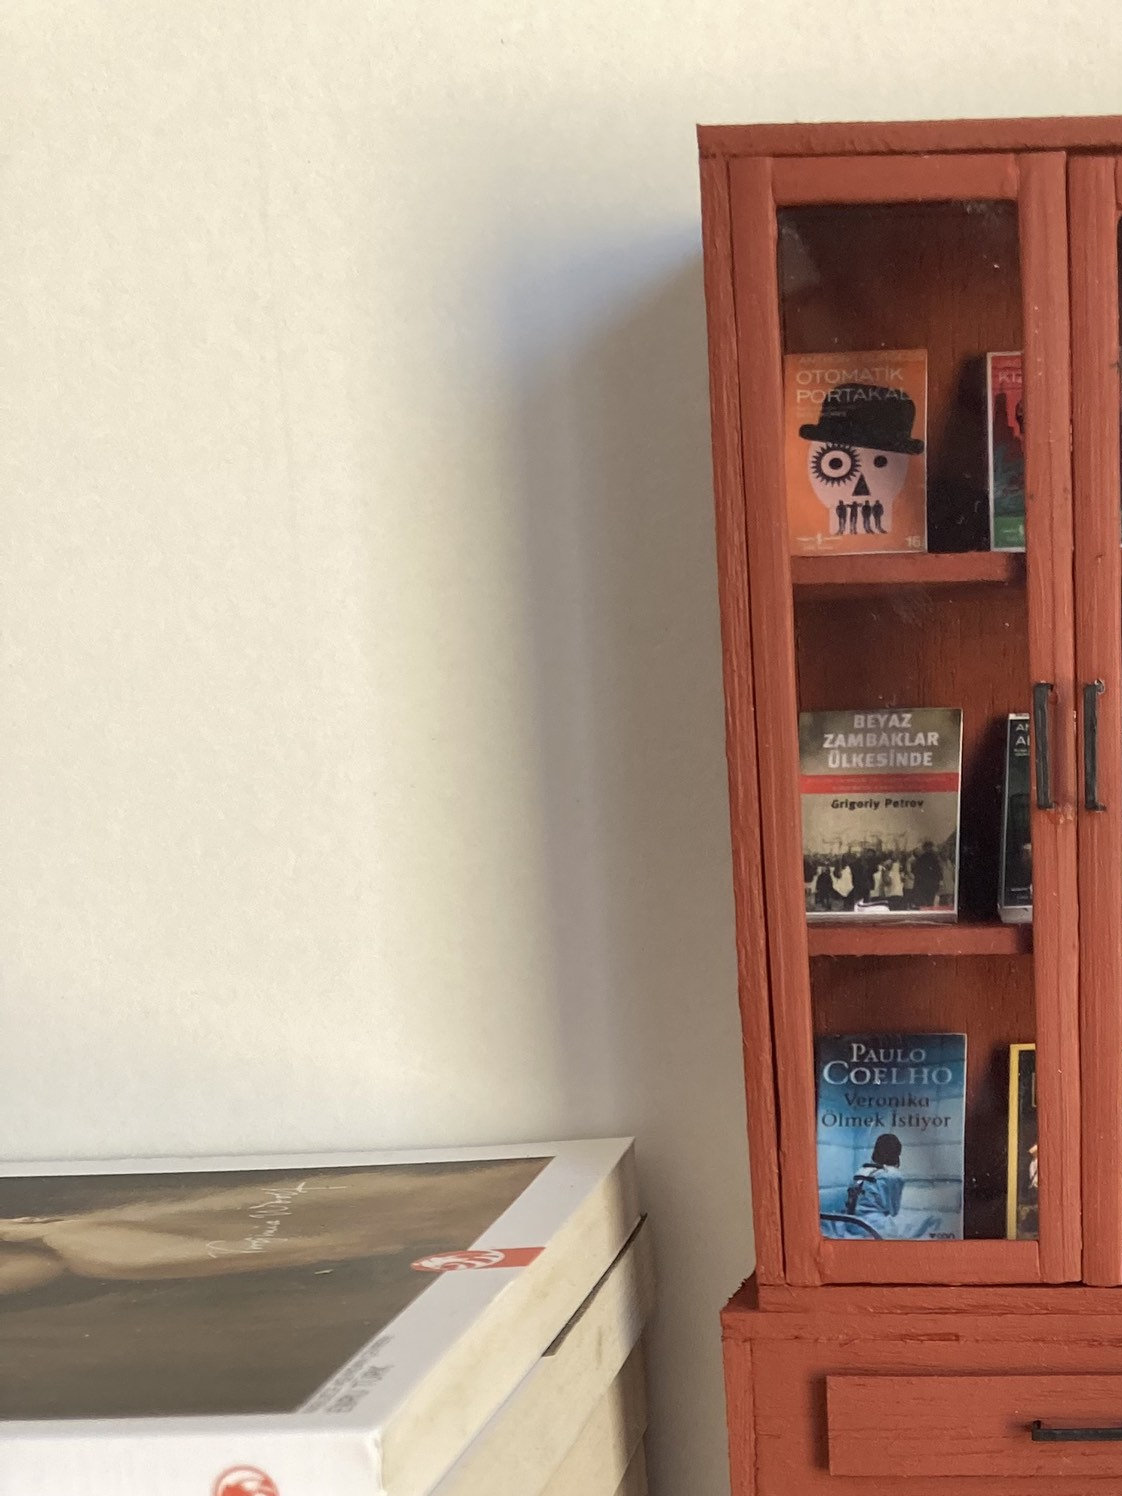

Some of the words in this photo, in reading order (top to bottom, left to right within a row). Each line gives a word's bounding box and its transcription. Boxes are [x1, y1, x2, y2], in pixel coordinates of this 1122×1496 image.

[796, 366, 904, 385] OTOMATİK
[796, 387, 911, 404] PORTAKAL
[853, 713, 912, 729] BEYAZ
[822, 731, 939, 749] ZAMBAKLAR
[828, 749, 933, 768] ÜLKESİNDE
[831, 798, 880, 810] Grigoriy
[885, 798, 924, 809] Petrov
[851, 1043, 927, 1062] PAULO
[823, 1060, 952, 1085] COELHO
[845, 1092, 930, 1108] Veronika
[821, 1110, 886, 1128] Ölmek
